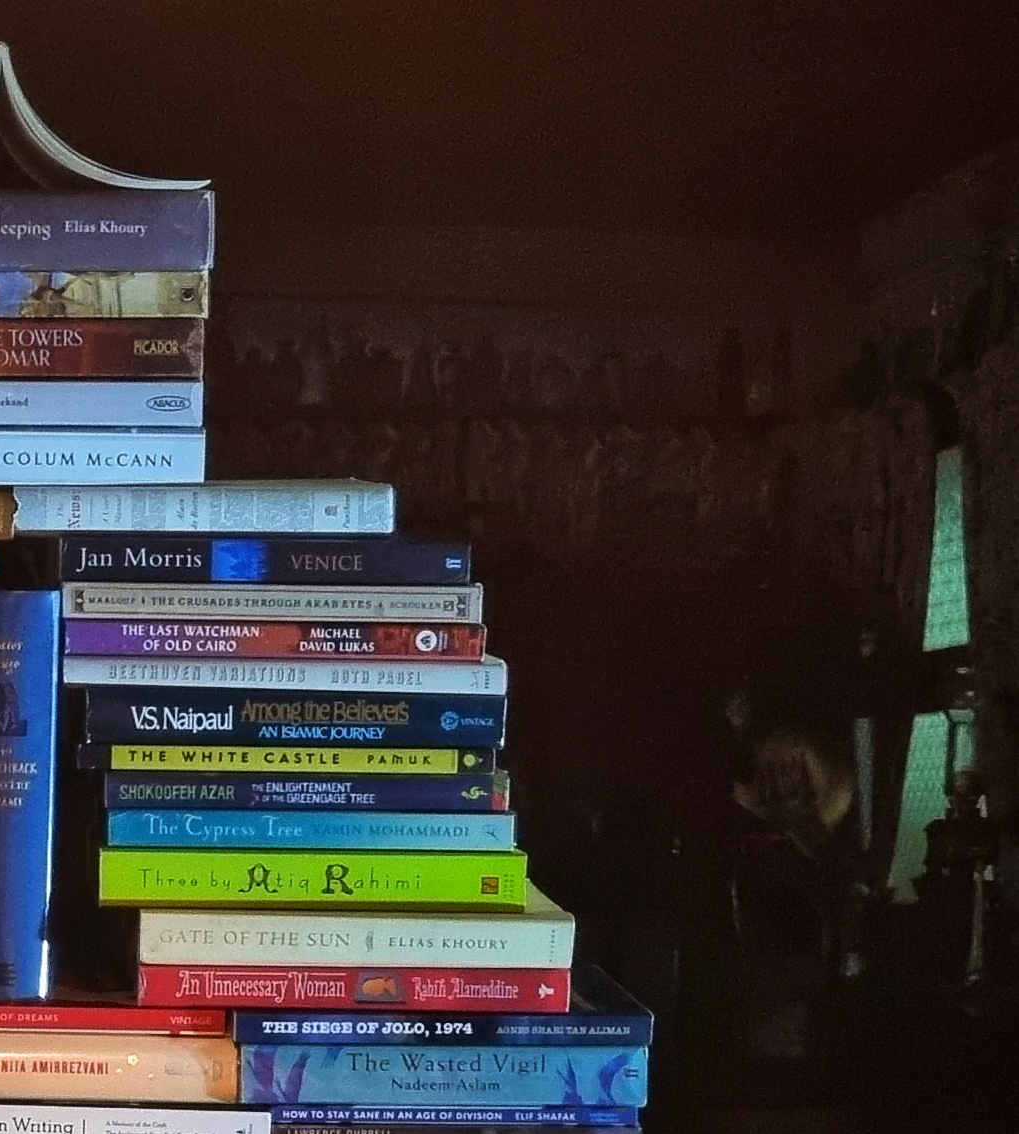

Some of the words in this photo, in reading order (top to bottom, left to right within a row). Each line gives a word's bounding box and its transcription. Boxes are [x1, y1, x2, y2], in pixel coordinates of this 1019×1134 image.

[65, 221, 96, 233] Elias
[99, 221, 147, 236] Khoury
[3, 452, 75, 466] COLUM
[86, 453, 173, 467] McCANN
[77, 549, 112, 572] Jan
[124, 548, 203, 567] Morris
[291, 554, 363, 571] VENICE
[122, 625, 146, 637] THE
[149, 625, 181, 637] LAST
[185, 625, 260, 637] WATCHMAN
[143, 639, 164, 651] OF
[167, 639, 191, 651] OLD
[196, 639, 237, 652] CAIRO
[129, 750, 168, 762] THE
[182, 750, 249, 763] WHITE
[264, 751, 340, 764] CASTLE
[160, 929, 215, 946] GATE
[223, 930, 251, 947] OF
[255, 930, 299, 947] THE
[307, 931, 349, 947] SUN
[262, 1021, 297, 1035] THE
[302, 1021, 352, 1035] SIEGE
[357, 1021, 378, 1035] OF
[383, 1021, 429, 1037] JOLO,
[435, 1021, 472, 1035] 1974
[283, 1110, 306, 1119] HOW
[309, 1110, 323, 1120] TO
[326, 1110, 350, 1120] STAY
[353, 1110, 379, 1120] SANE
[383, 1111, 392, 1120] IN
[395, 1111, 411, 1120] AN
[414, 1111, 435, 1120] AGE
[438, 1111, 452, 1120] OF
[456, 1111, 502, 1120] DIVISION
[515, 1111, 534, 1120] ELIF
[537, 1112, 576, 1121] SHAFAK
